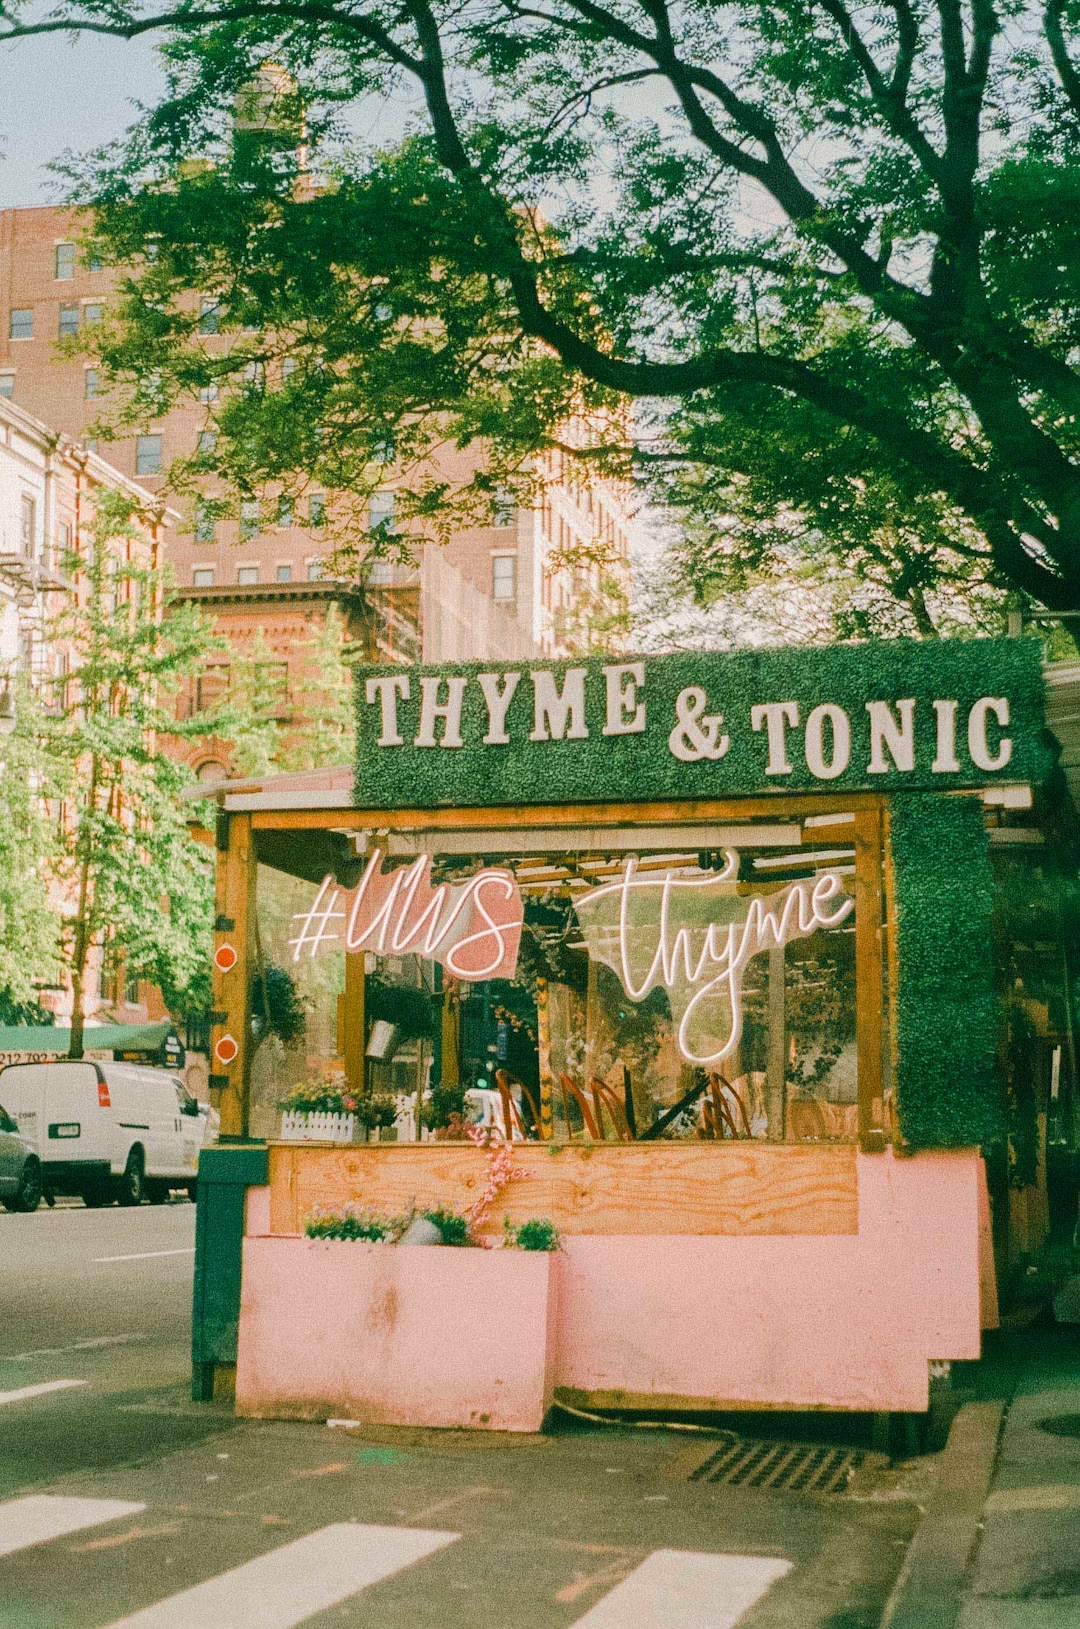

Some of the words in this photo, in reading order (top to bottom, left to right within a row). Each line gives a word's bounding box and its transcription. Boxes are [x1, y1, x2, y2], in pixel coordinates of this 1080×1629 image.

[365, 662, 647, 748] THYME
[668, 686, 731, 762] &
[750, 696, 1013, 779] TONIC
[288, 848, 523, 976] #UWS
